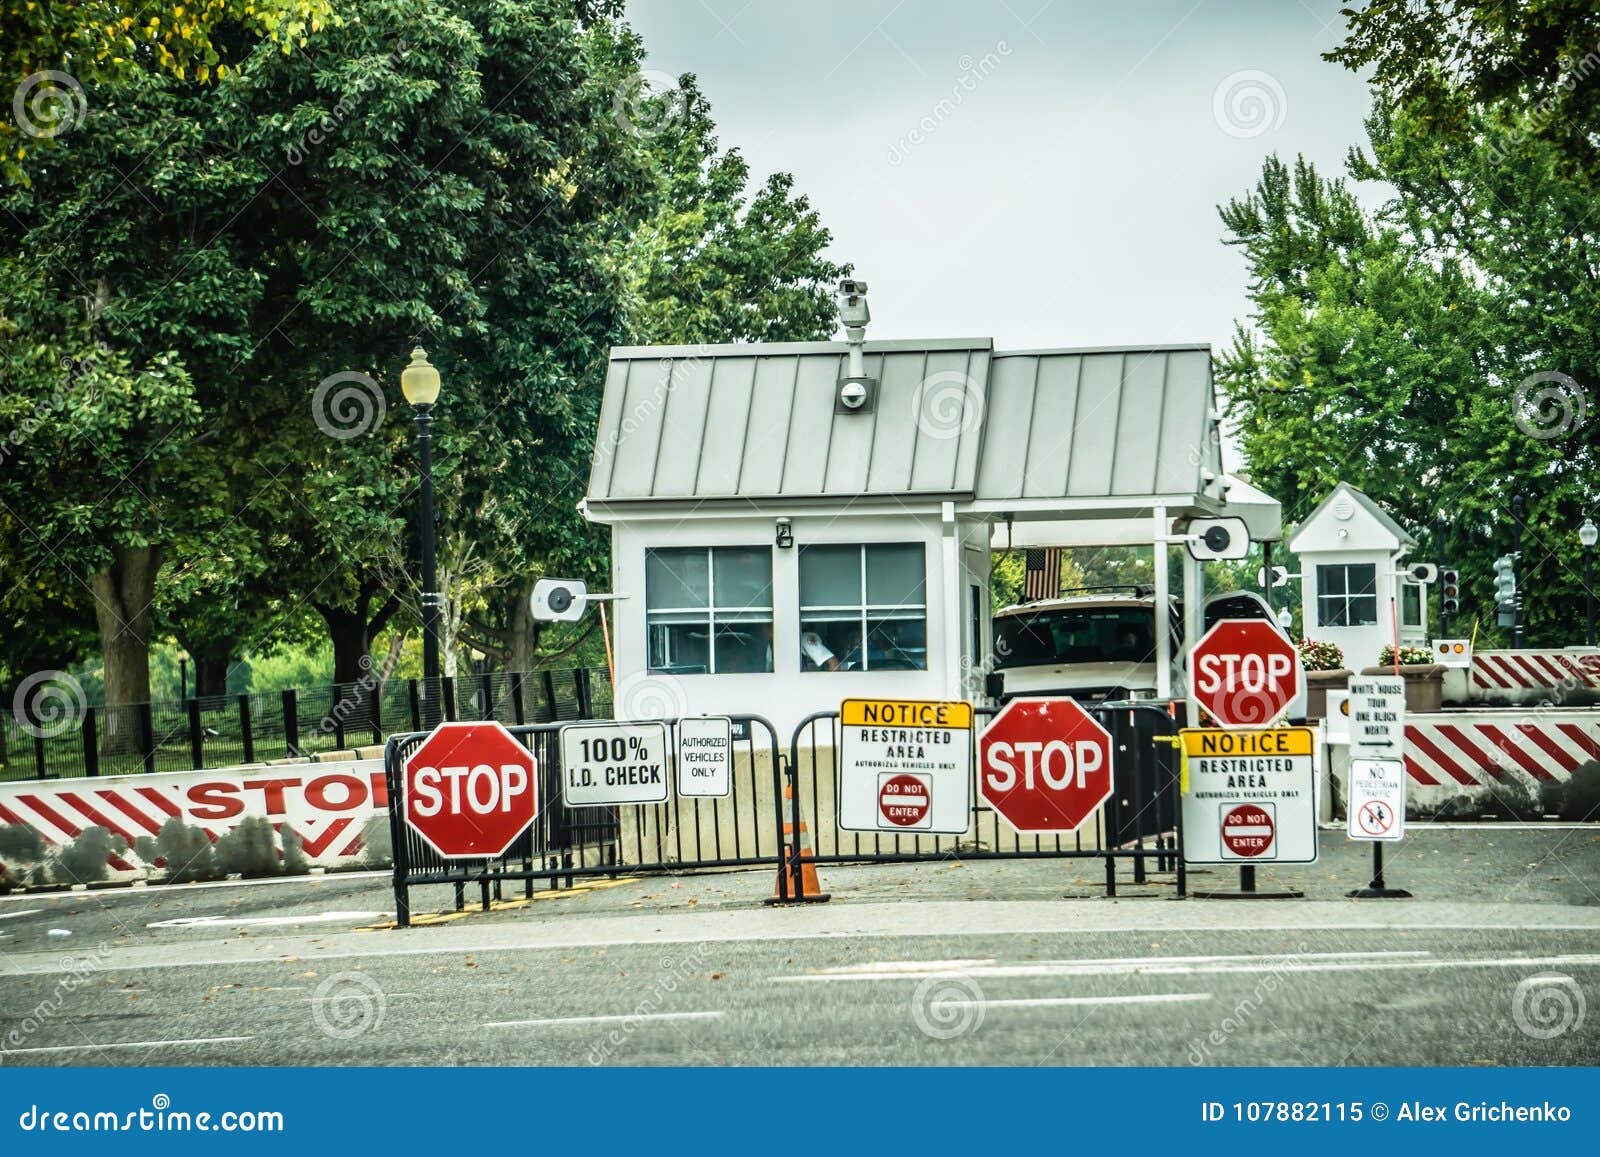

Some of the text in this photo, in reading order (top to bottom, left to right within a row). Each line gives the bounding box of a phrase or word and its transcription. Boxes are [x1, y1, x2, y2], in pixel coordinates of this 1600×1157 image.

[1198, 653, 1291, 694] STOP
[1351, 684, 1402, 694] WHITE HOUSE
[1368, 698, 1386, 707] TOUR
[864, 703, 949, 724] NOTICE
[1356, 711, 1397, 721] ONE BLOCK
[1365, 725, 1388, 735] NORTH
[682, 737, 727, 748] AUTHORIZED
[861, 729, 951, 745] RESTRICTED
[1202, 733, 1290, 753] NOTICE
[580, 736, 648, 763] 100%
[887, 745, 925, 758] AREA
[685, 752, 725, 762] VEHICLES
[986, 739, 1103, 791] STOP
[1200, 759, 1293, 773] RESTRICTED
[570, 765, 661, 788] I.D. CHECK
[692, 767, 716, 778] ONLY
[1369, 767, 1385, 779] NO
[1227, 774, 1266, 788] AREA
[413, 764, 529, 818] STOP
[886, 784, 922, 794] DO NOT
[889, 807, 919, 817] ENTER
[1228, 814, 1266, 824] DO NOT
[1233, 838, 1264, 848] ENTER
